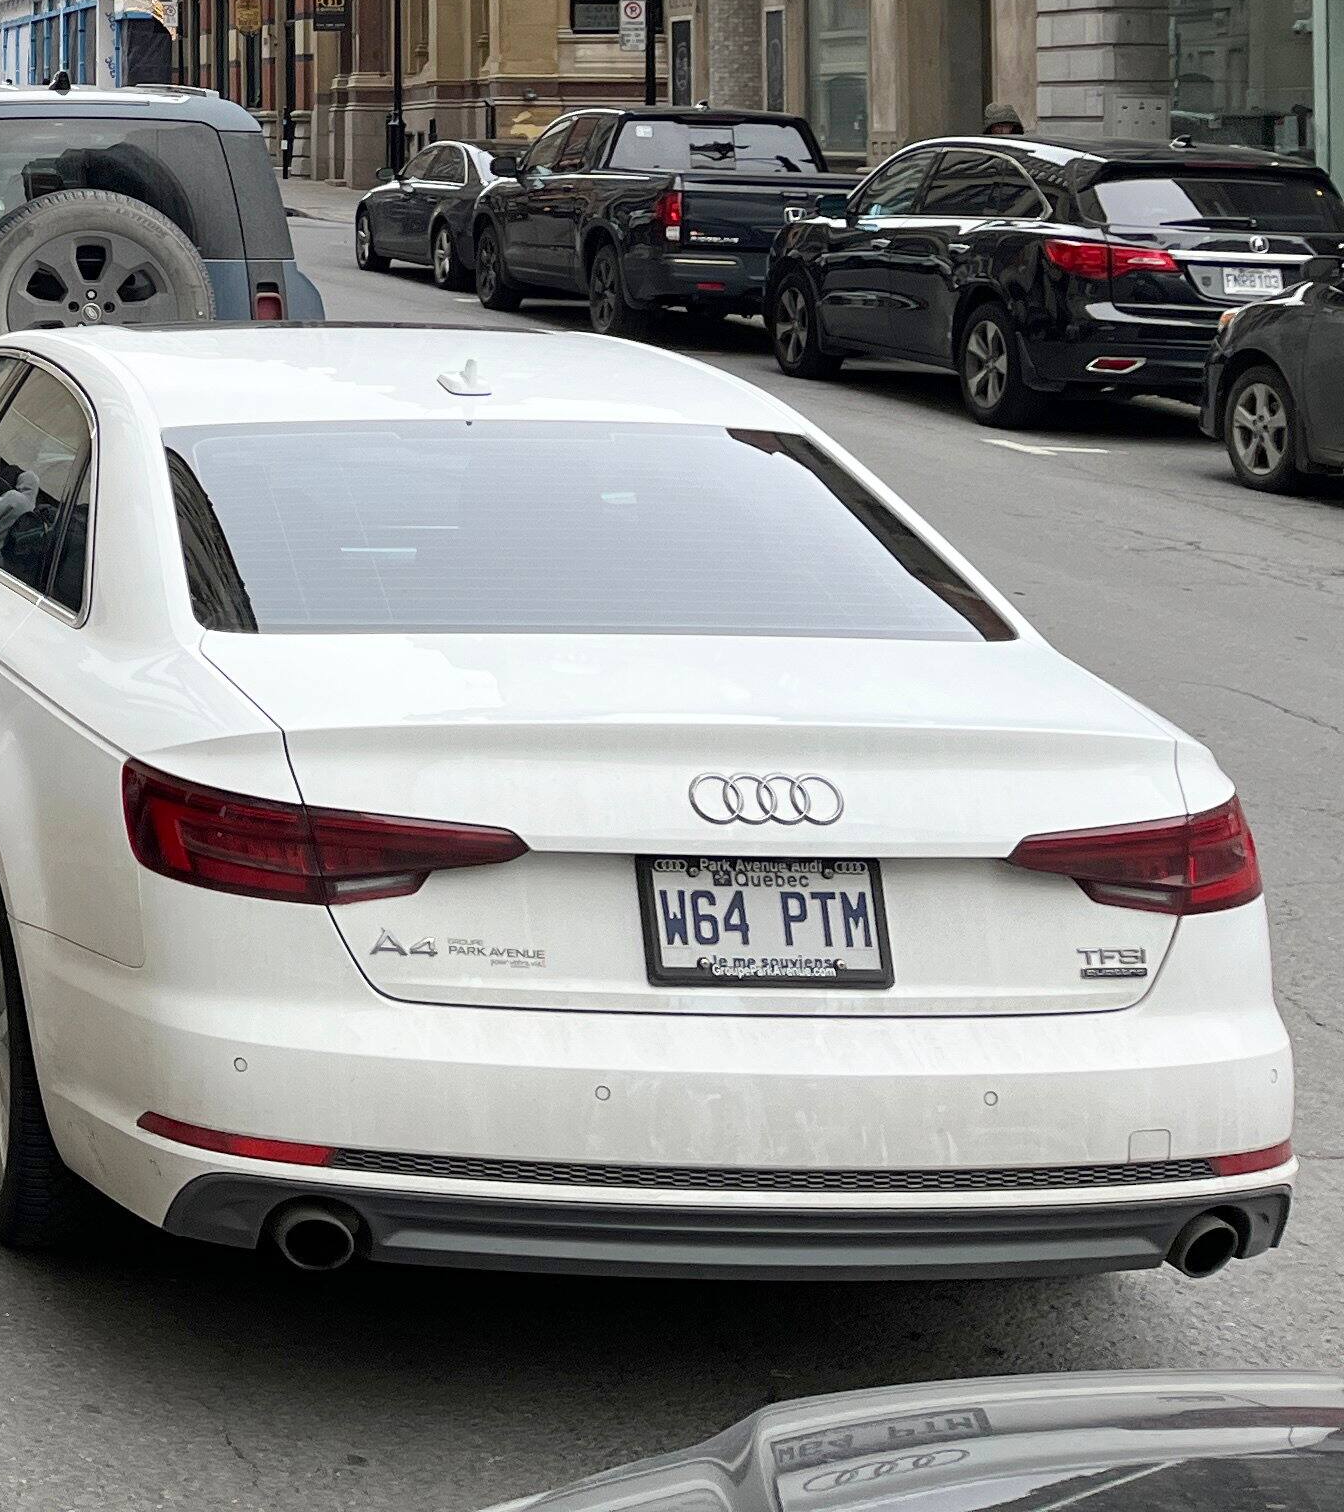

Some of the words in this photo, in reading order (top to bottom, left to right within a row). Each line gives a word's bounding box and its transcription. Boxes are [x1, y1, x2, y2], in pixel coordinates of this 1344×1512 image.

[699, 858, 733, 872] Park
[735, 859, 787, 873] Avenue
[791, 859, 823, 874] Audi
[659, 889, 750, 946] W64
[779, 891, 873, 948] PTM
[369, 927, 438, 958] A4
[448, 945, 487, 957] PARK
[489, 947, 546, 960] AVENUE
[1075, 947, 1147, 966] TFSI
[732, 957, 756, 968] me
[761, 954, 834, 969] souviens
[711, 963, 837, 979] GroupeParkAvenue.com
